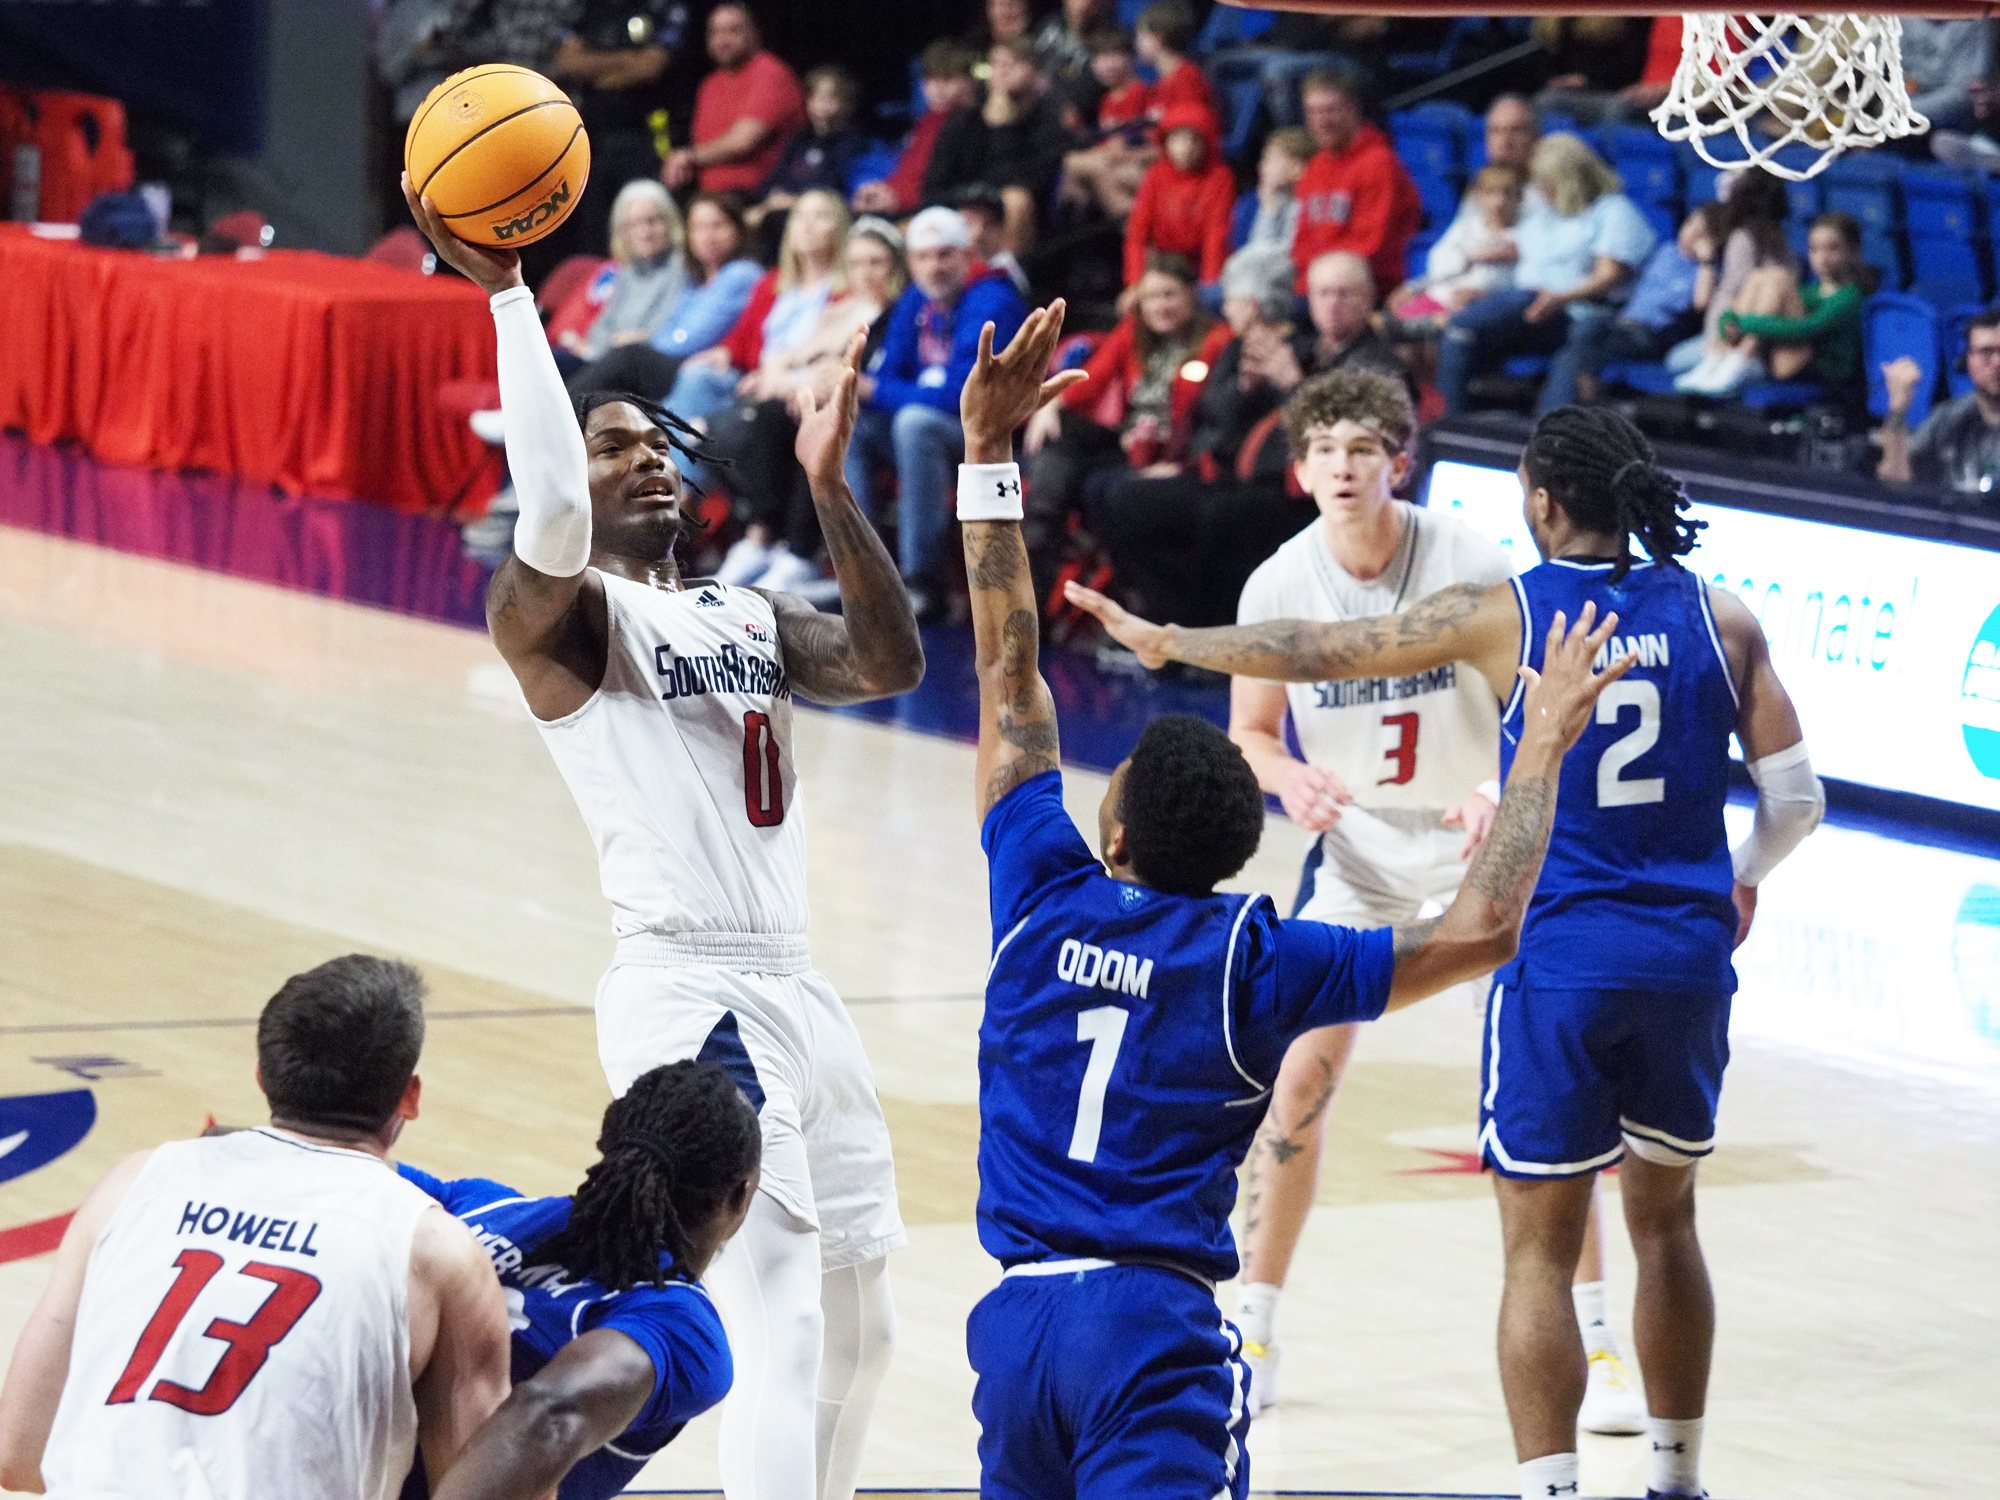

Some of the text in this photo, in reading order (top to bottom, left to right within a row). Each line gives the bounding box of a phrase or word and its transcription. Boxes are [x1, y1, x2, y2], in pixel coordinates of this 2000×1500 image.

[492, 180, 570, 240] NCAA
[743, 709, 784, 828] 0
[1376, 711, 1420, 787] 3
[1596, 679, 1666, 808] 2
[1057, 938, 1154, 1000] ODOM
[1067, 1005, 1129, 1163] 1
[176, 1200, 319, 1257] HOWELL
[104, 1248, 323, 1417] 13
